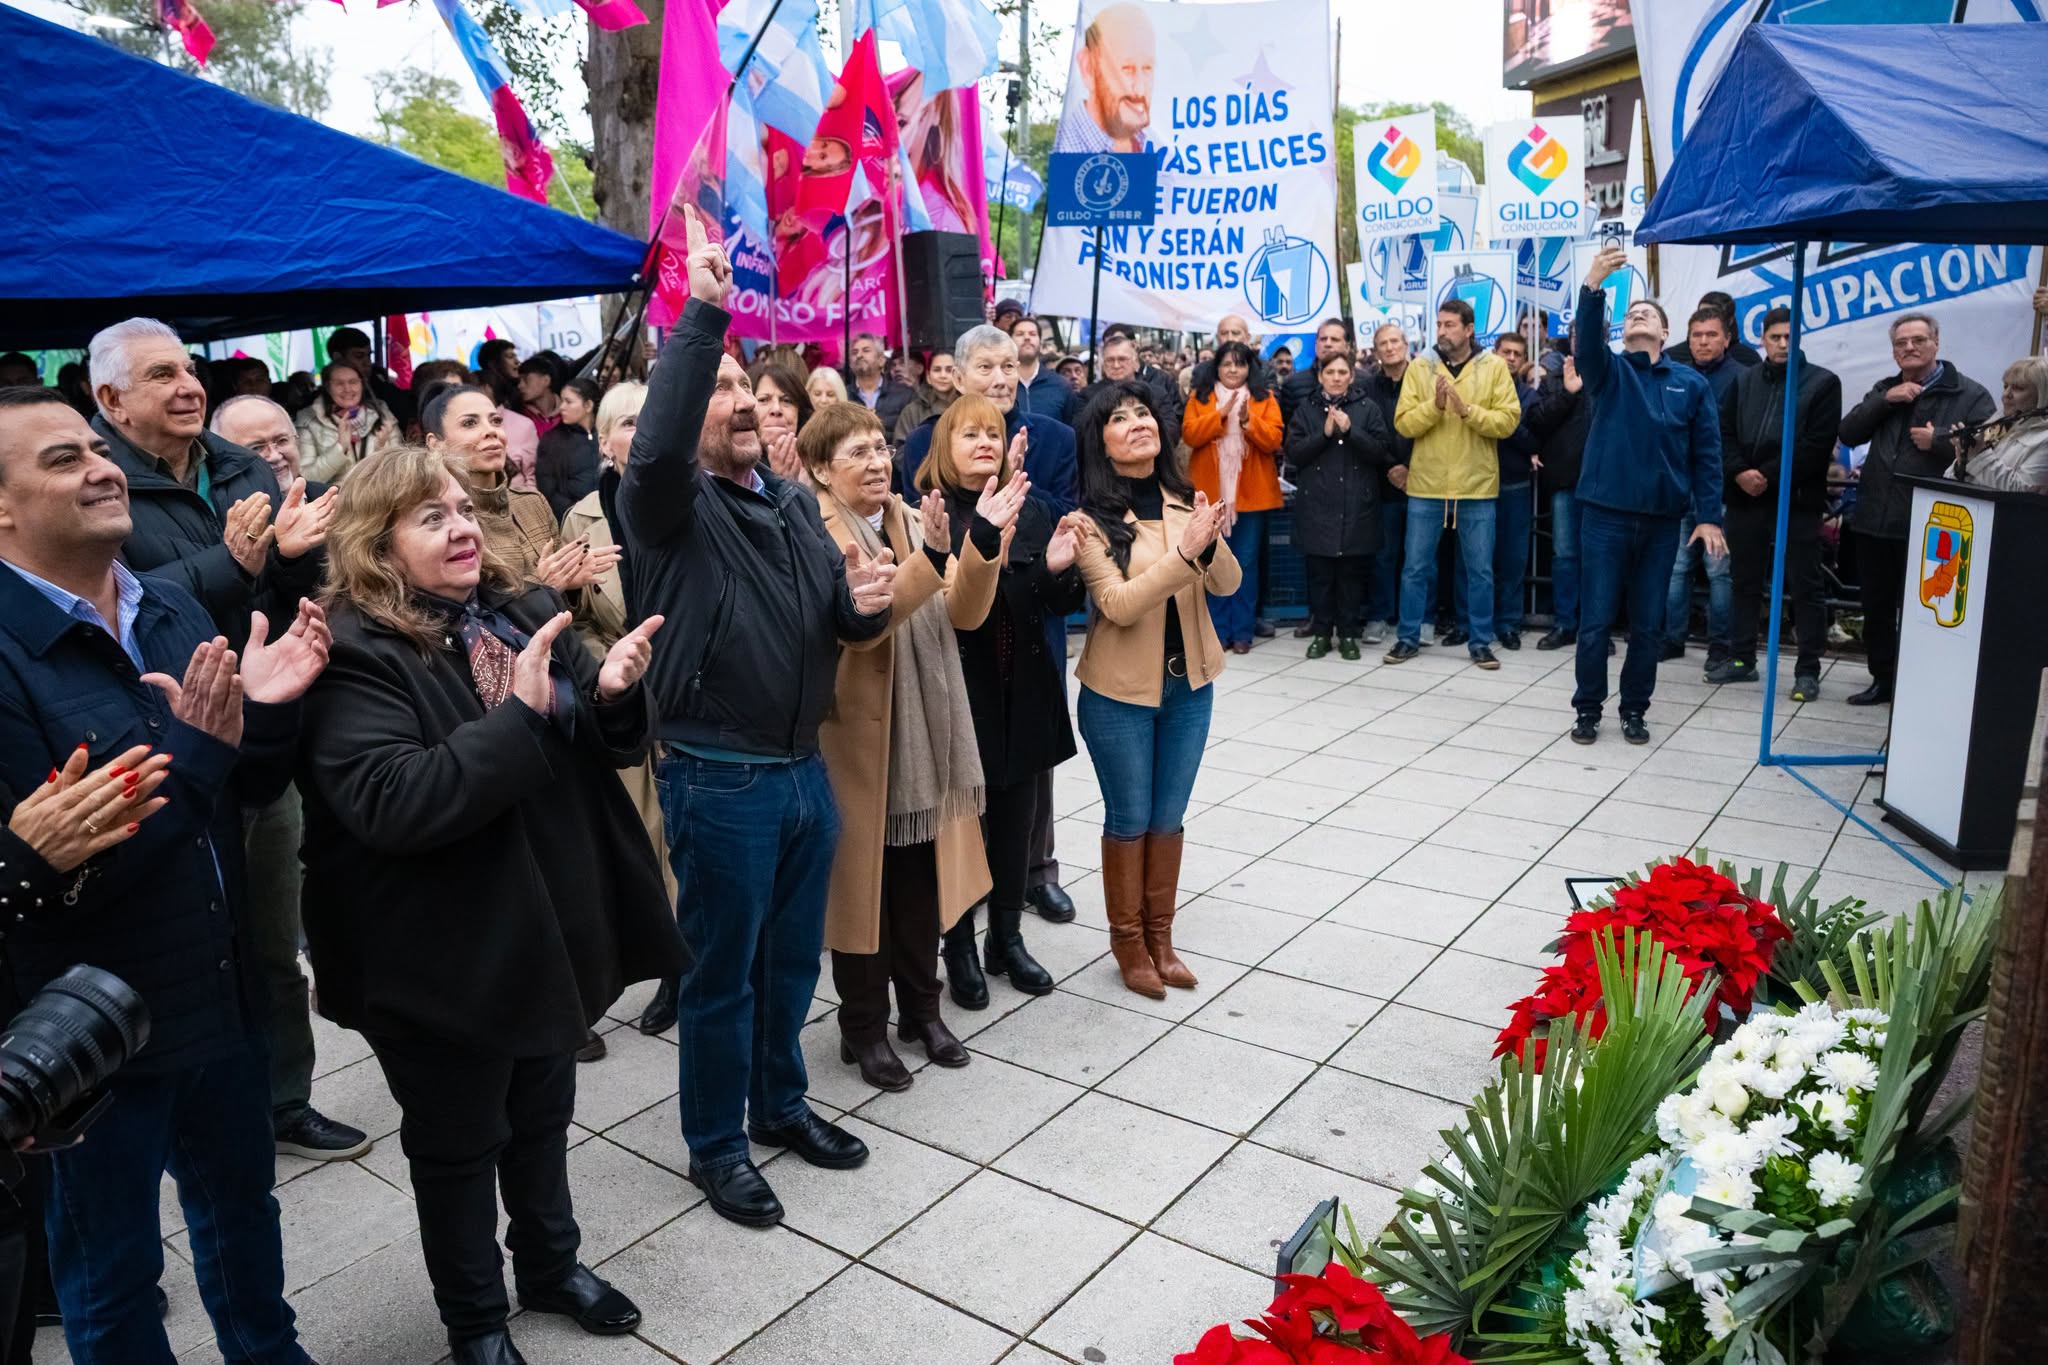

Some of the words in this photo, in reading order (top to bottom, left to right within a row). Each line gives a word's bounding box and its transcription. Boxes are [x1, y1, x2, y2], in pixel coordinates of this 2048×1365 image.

[1172, 96, 1217, 129] LOS
[1226, 82, 1289, 126] DÍAS
[1208, 132, 1327, 174] FELICES
[1171, 183, 1278, 215] FUERON
[1362, 197, 1433, 222] GILDO
[1500, 200, 1579, 221] GILDO
[1057, 211, 1091, 220] GILDO
[1365, 216, 1432, 233] CONDUCCIÓN
[1502, 220, 1577, 233] CONDUCCIÓN
[1138, 226, 1154, 254] Y
[1158, 219, 1244, 256] SERÁN
[1078, 241, 1239, 290] PERONISTAS
[1743, 244, 2007, 346] GUPACIÓN
